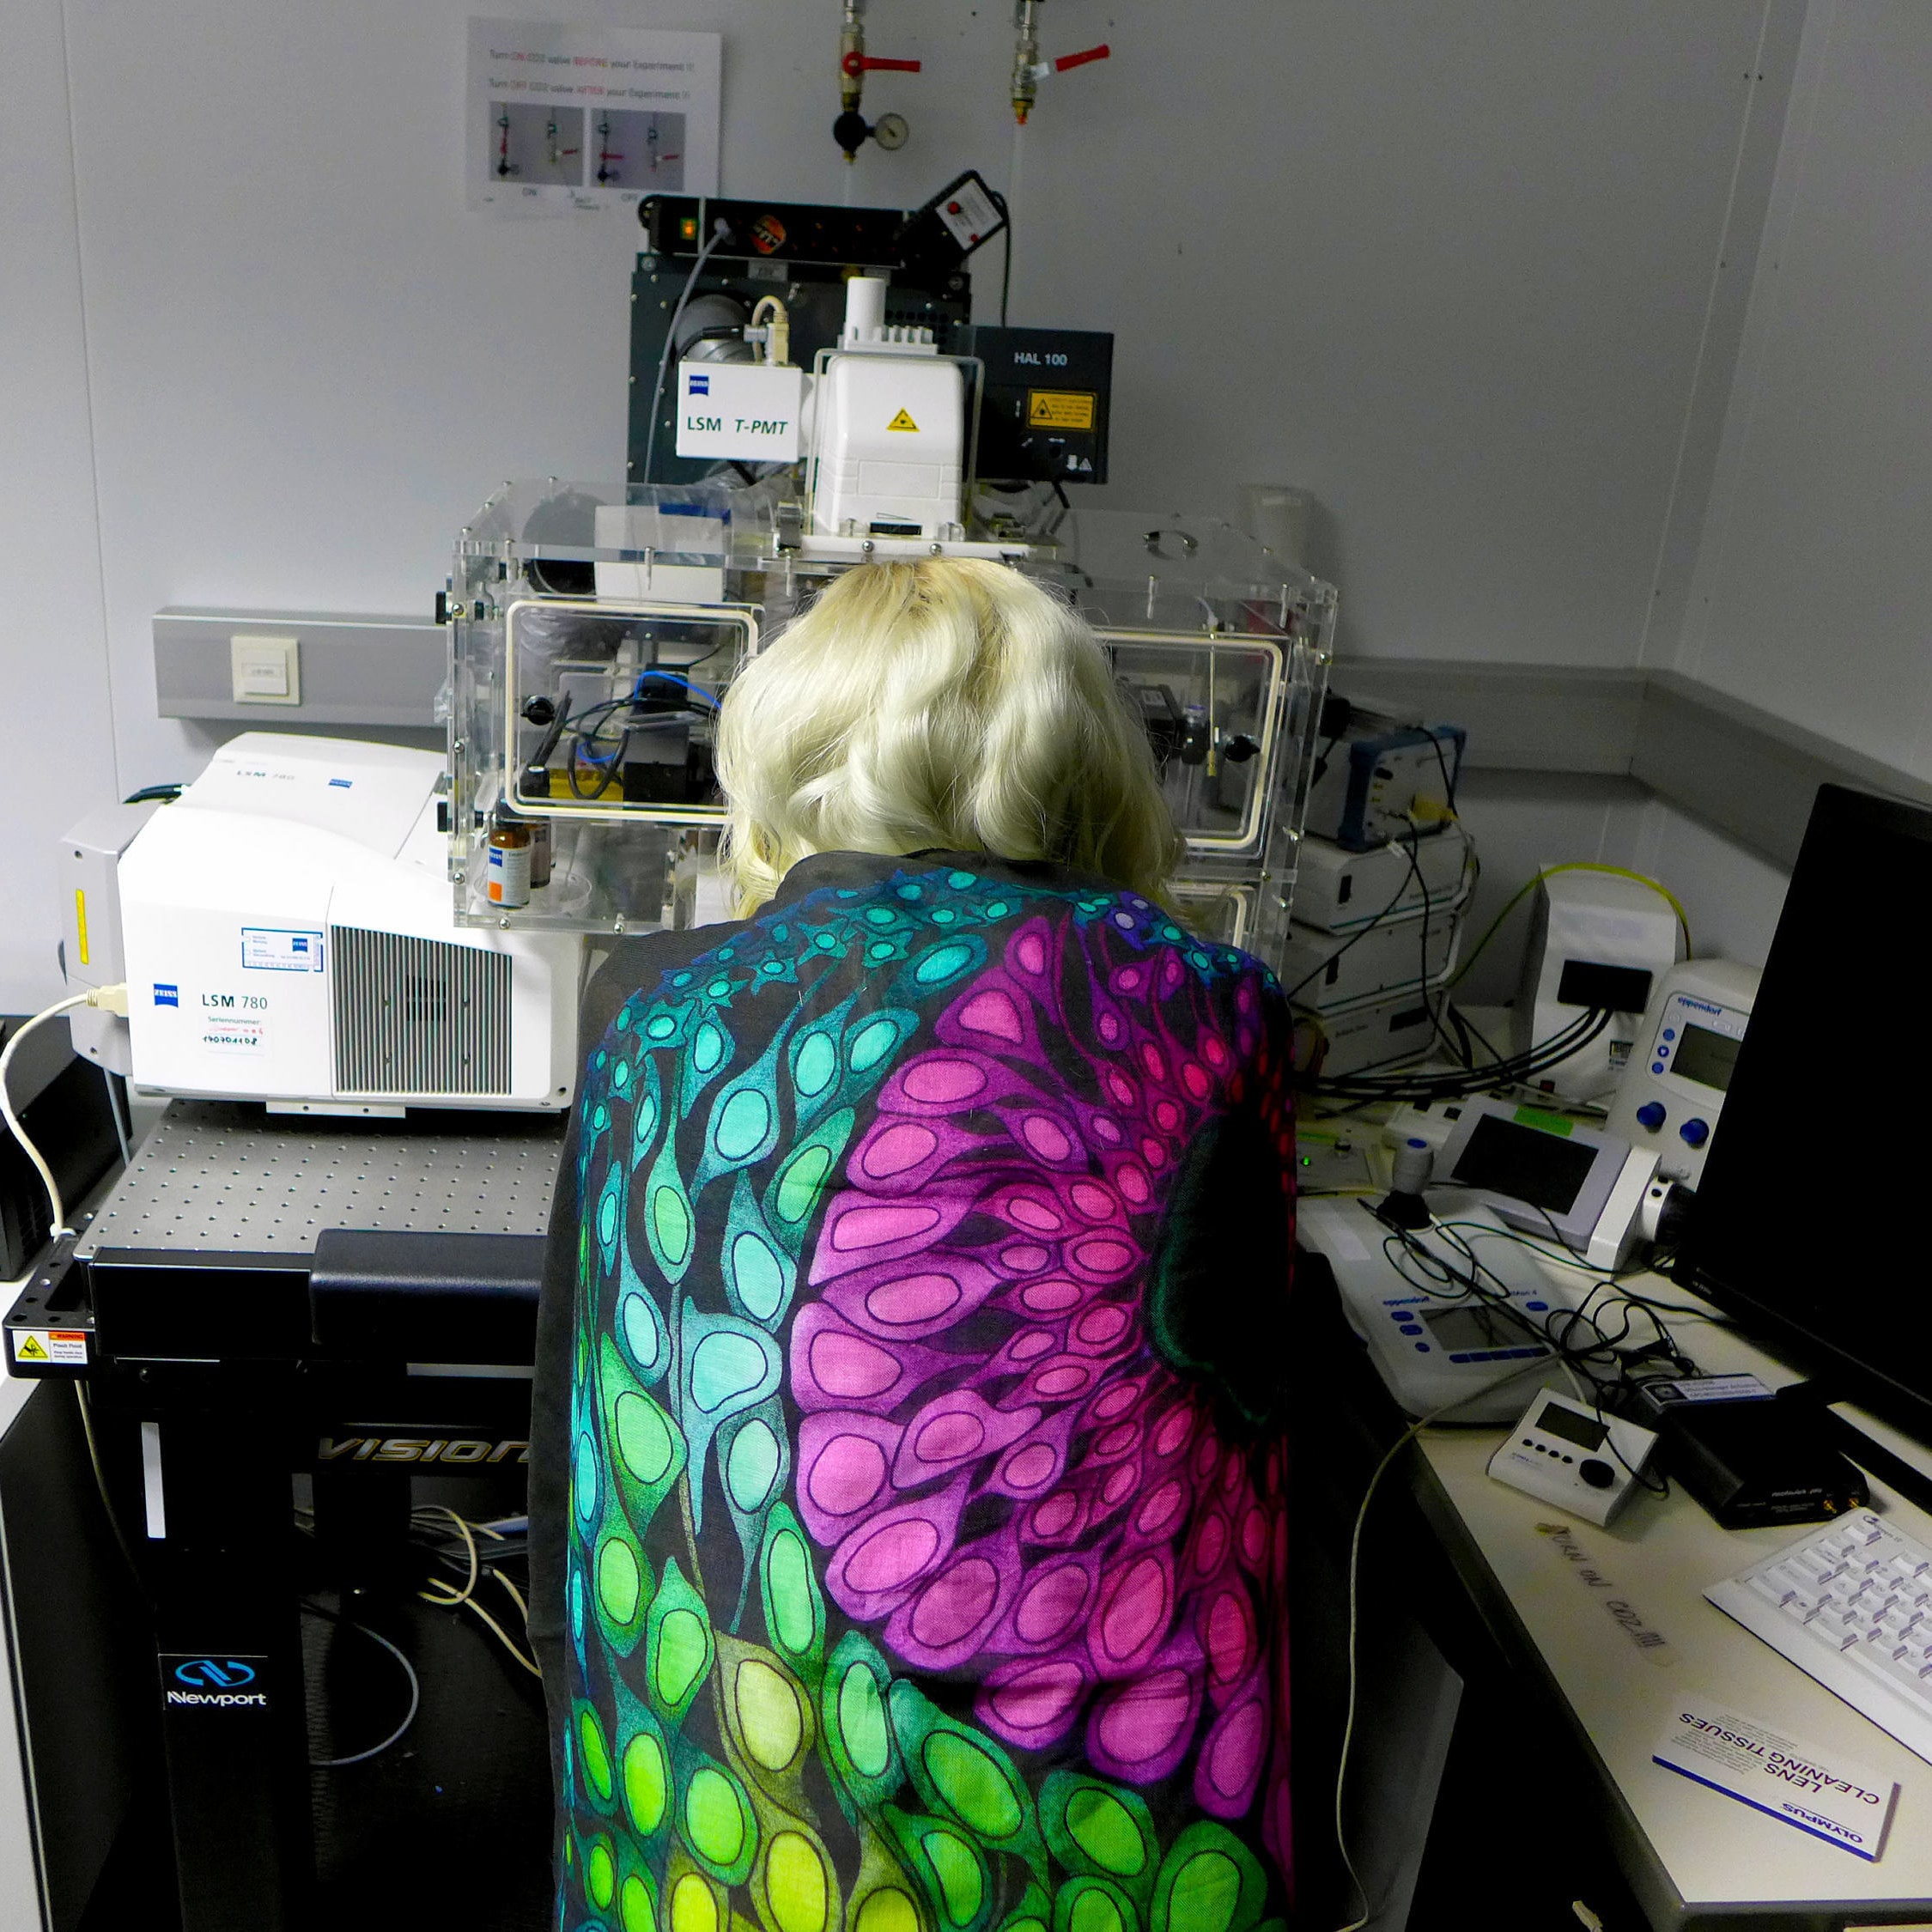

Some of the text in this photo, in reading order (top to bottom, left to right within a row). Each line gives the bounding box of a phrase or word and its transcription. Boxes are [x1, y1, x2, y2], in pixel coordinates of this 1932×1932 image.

[1013, 352, 1068, 366] HAL 100
[687, 416, 788, 435] LSM T-PMT
[154, 988, 178, 998] ZEISS
[202, 993, 268, 1010] LSM 780
[167, 1691, 267, 1707] Newport
[1678, 1713, 1765, 1757] TISSUES
[1764, 1762, 1823, 1793] LENS
[1769, 1752, 1880, 1805] CLEANING
[1781, 1801, 1863, 1844] OLYMPUS
